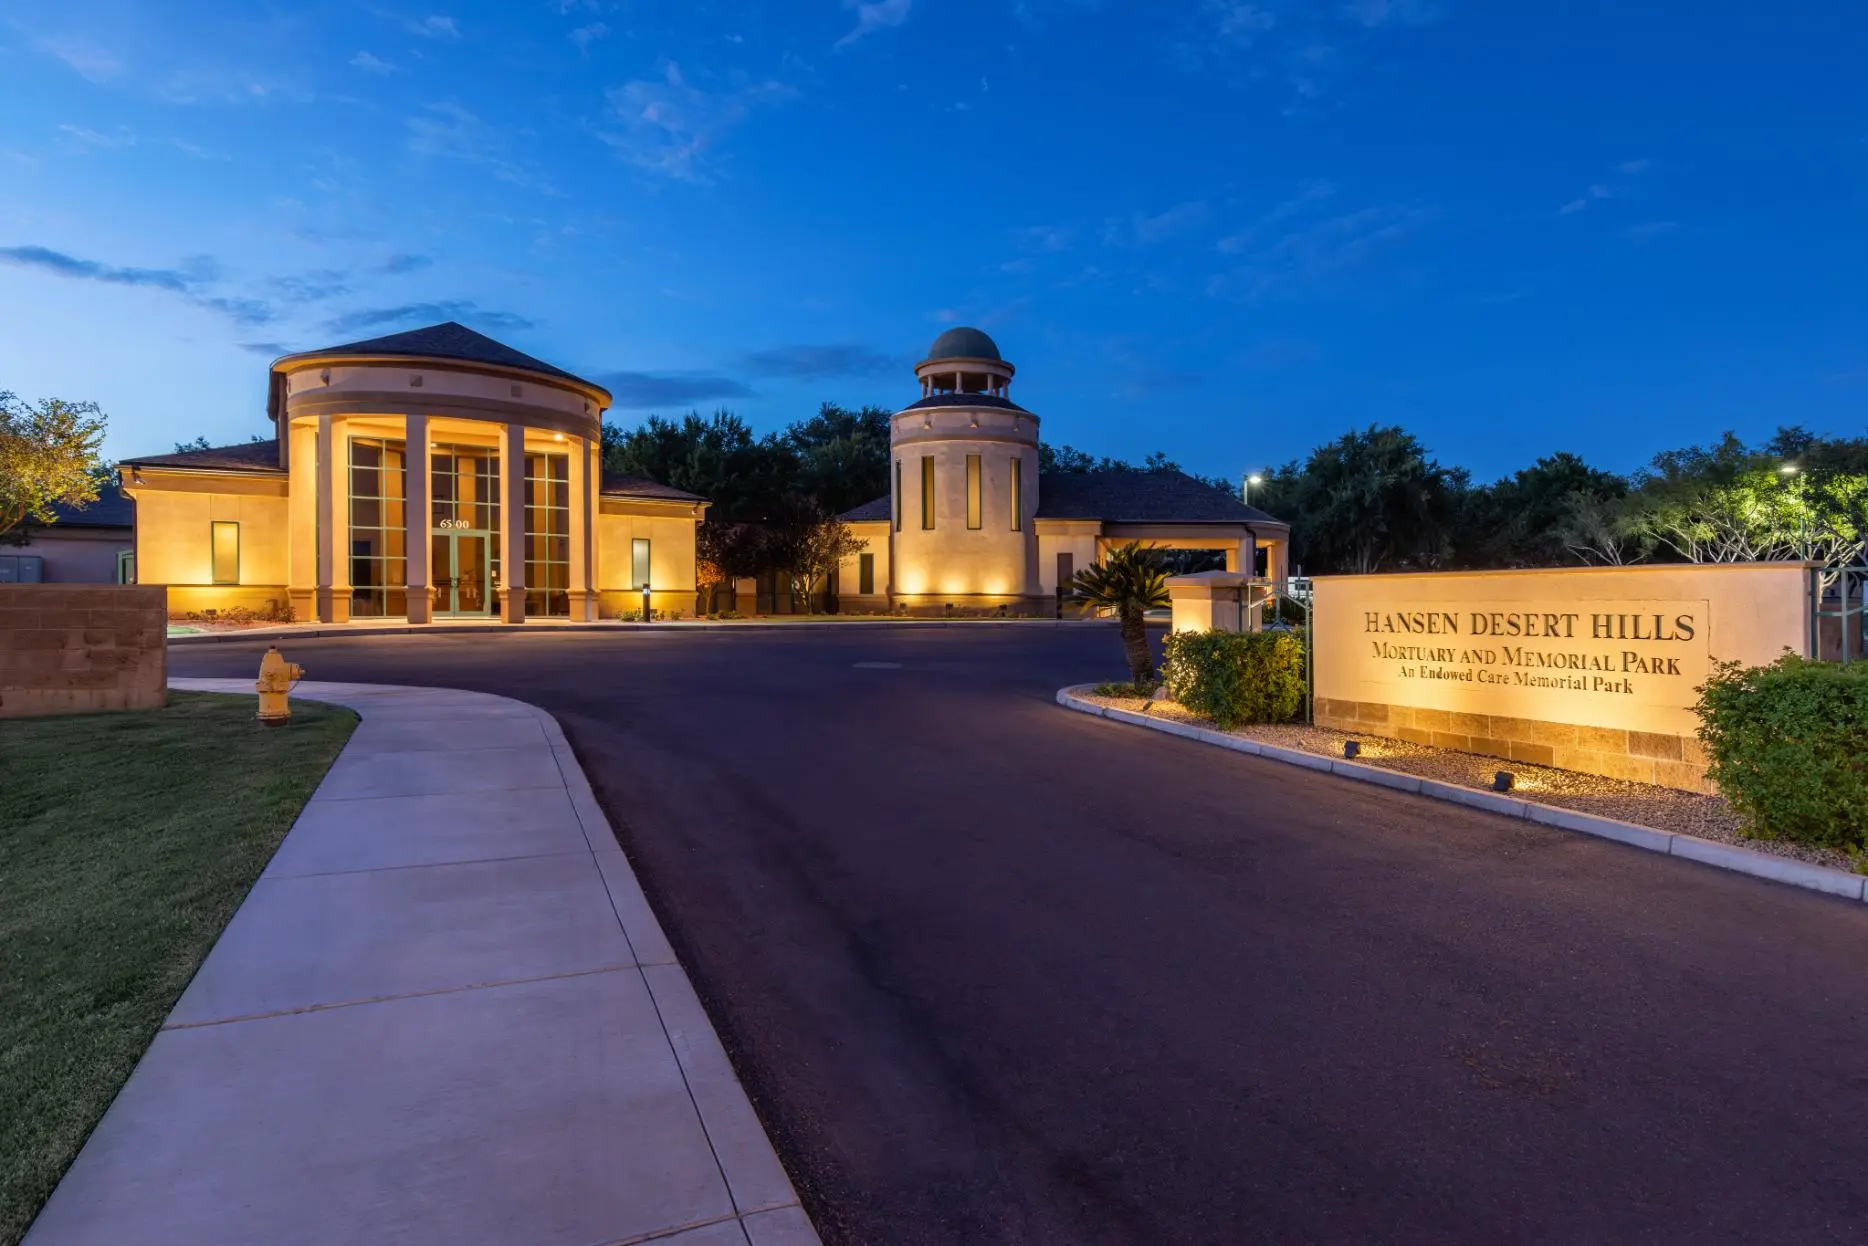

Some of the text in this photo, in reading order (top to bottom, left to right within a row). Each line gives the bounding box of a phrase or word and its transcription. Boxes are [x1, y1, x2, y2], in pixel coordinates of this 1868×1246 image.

[440, 519, 469, 529] 6500
[1364, 612, 1695, 641] HANSEN DESERT HILLS
[1372, 641, 1681, 675] MORTUARY AND MEMORIAL PARK
[1398, 664, 1634, 694] An Endowed Care Memorial Park
